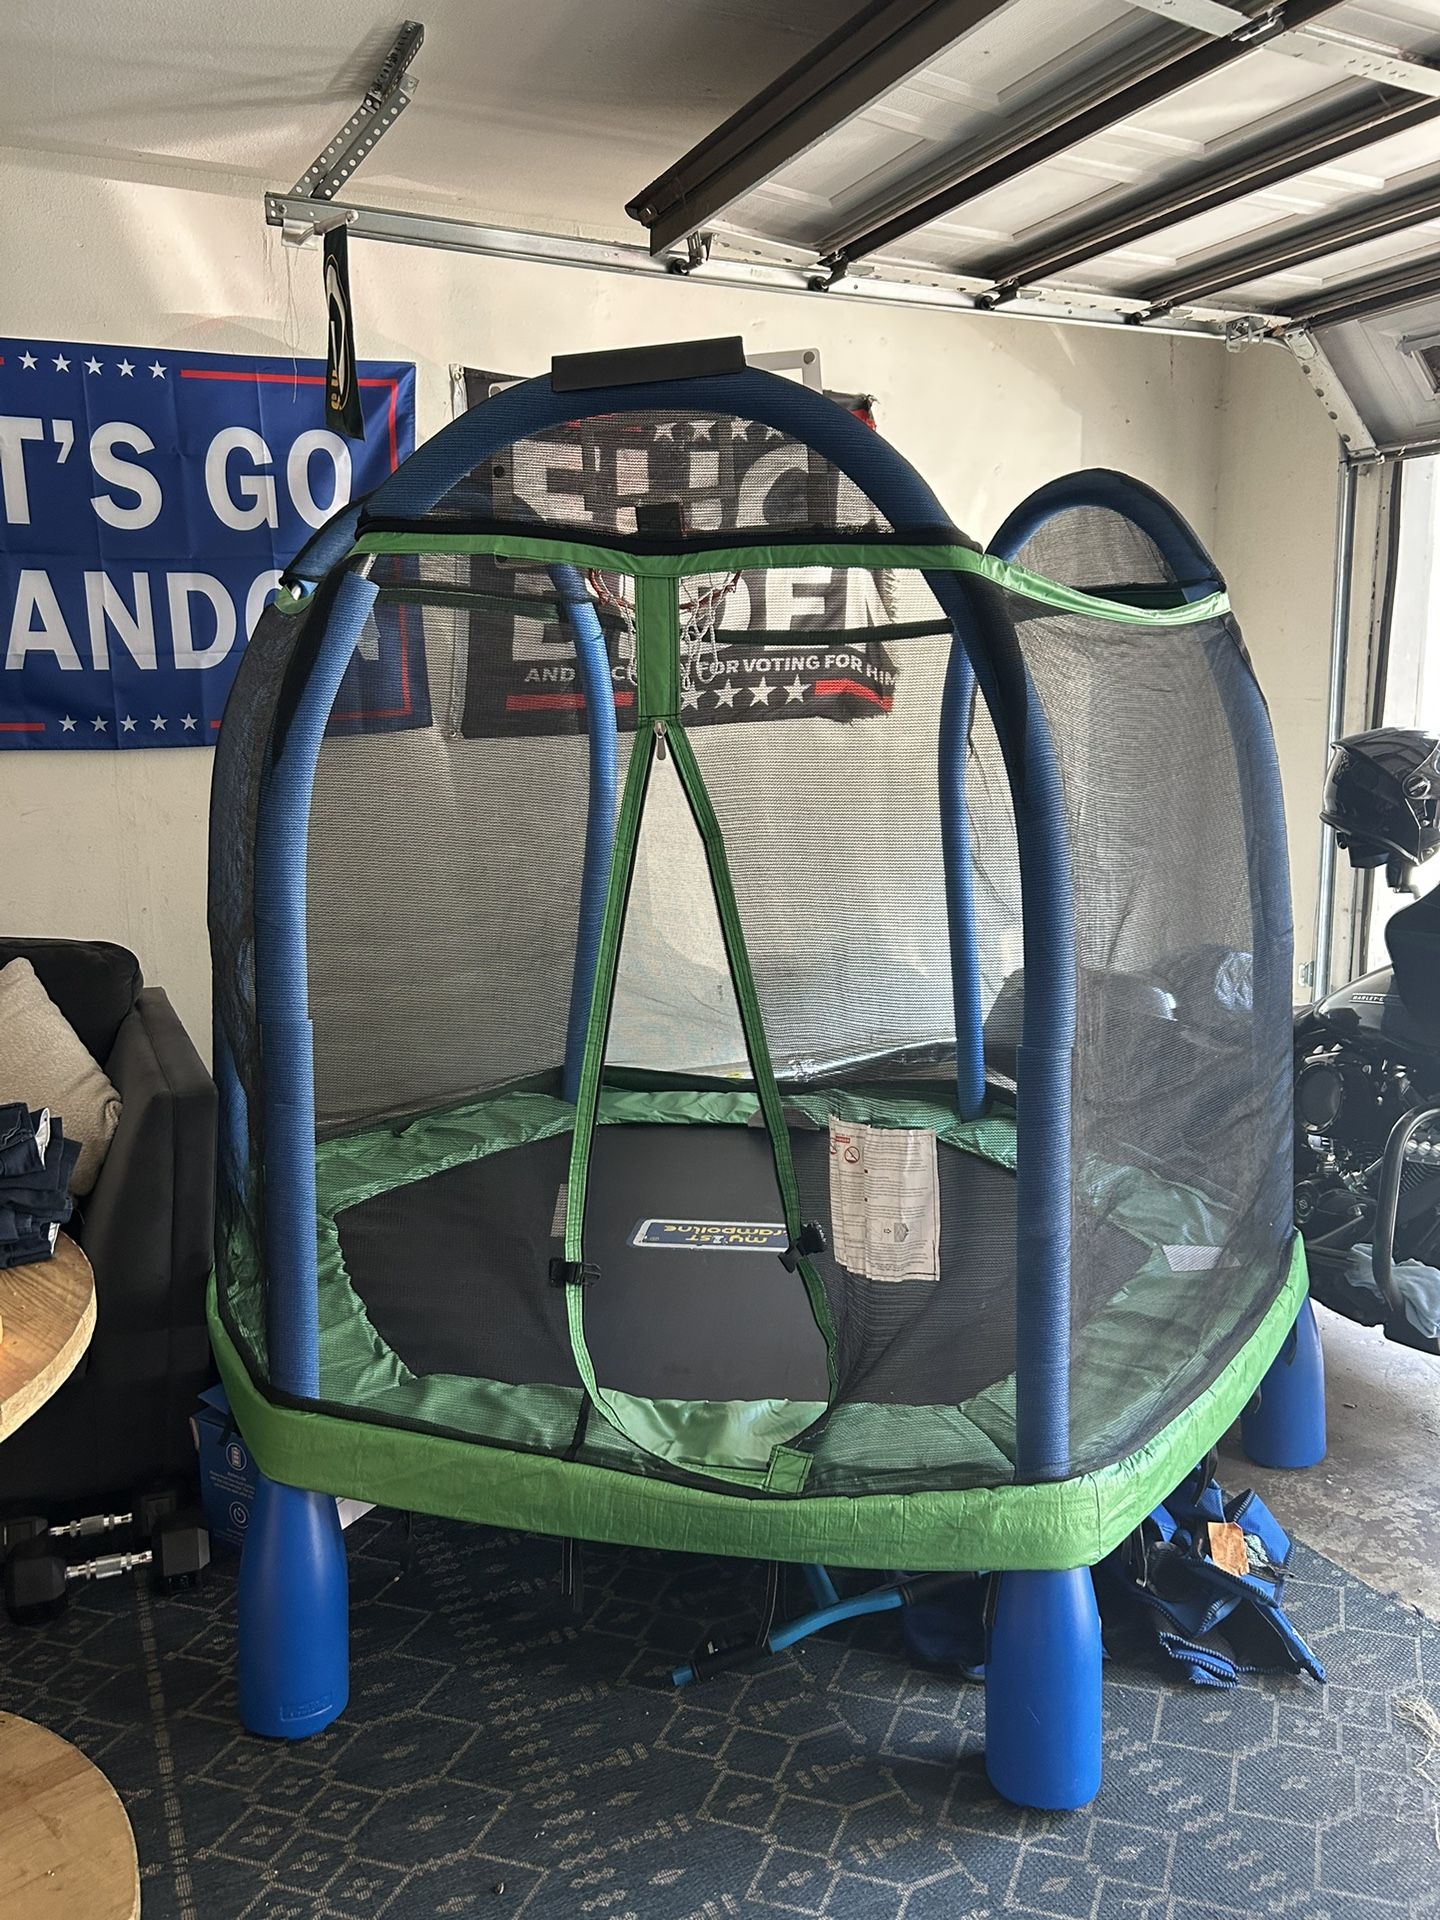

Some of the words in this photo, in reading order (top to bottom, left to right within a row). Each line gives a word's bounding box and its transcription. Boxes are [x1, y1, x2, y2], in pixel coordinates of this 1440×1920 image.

[205, 426, 352, 532] GO
[524, 666, 577, 682] AND
[698, 659, 740, 675] FOR
[742, 654, 821, 674] VOTING
[824, 653, 863, 674] FOR
[663, 1224, 788, 1237] rampoline
